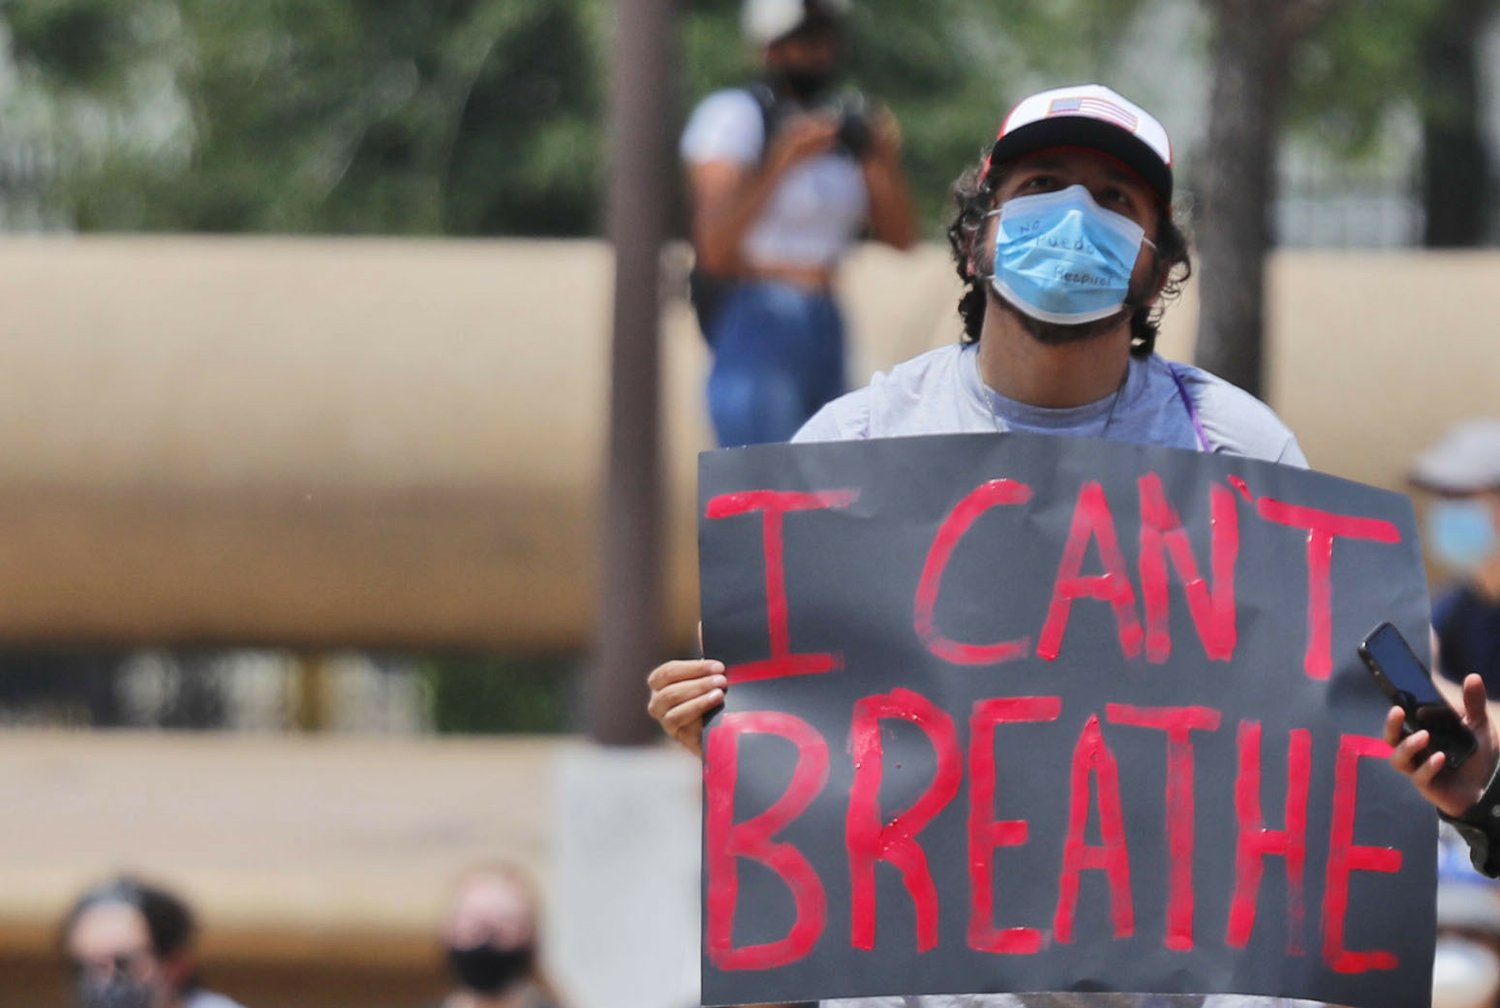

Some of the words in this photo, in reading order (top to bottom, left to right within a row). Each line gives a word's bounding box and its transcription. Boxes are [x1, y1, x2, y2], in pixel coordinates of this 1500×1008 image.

[705, 486, 861, 684] I
[914, 471, 1402, 681] CAN'T
[705, 686, 1404, 974] BREATHE
